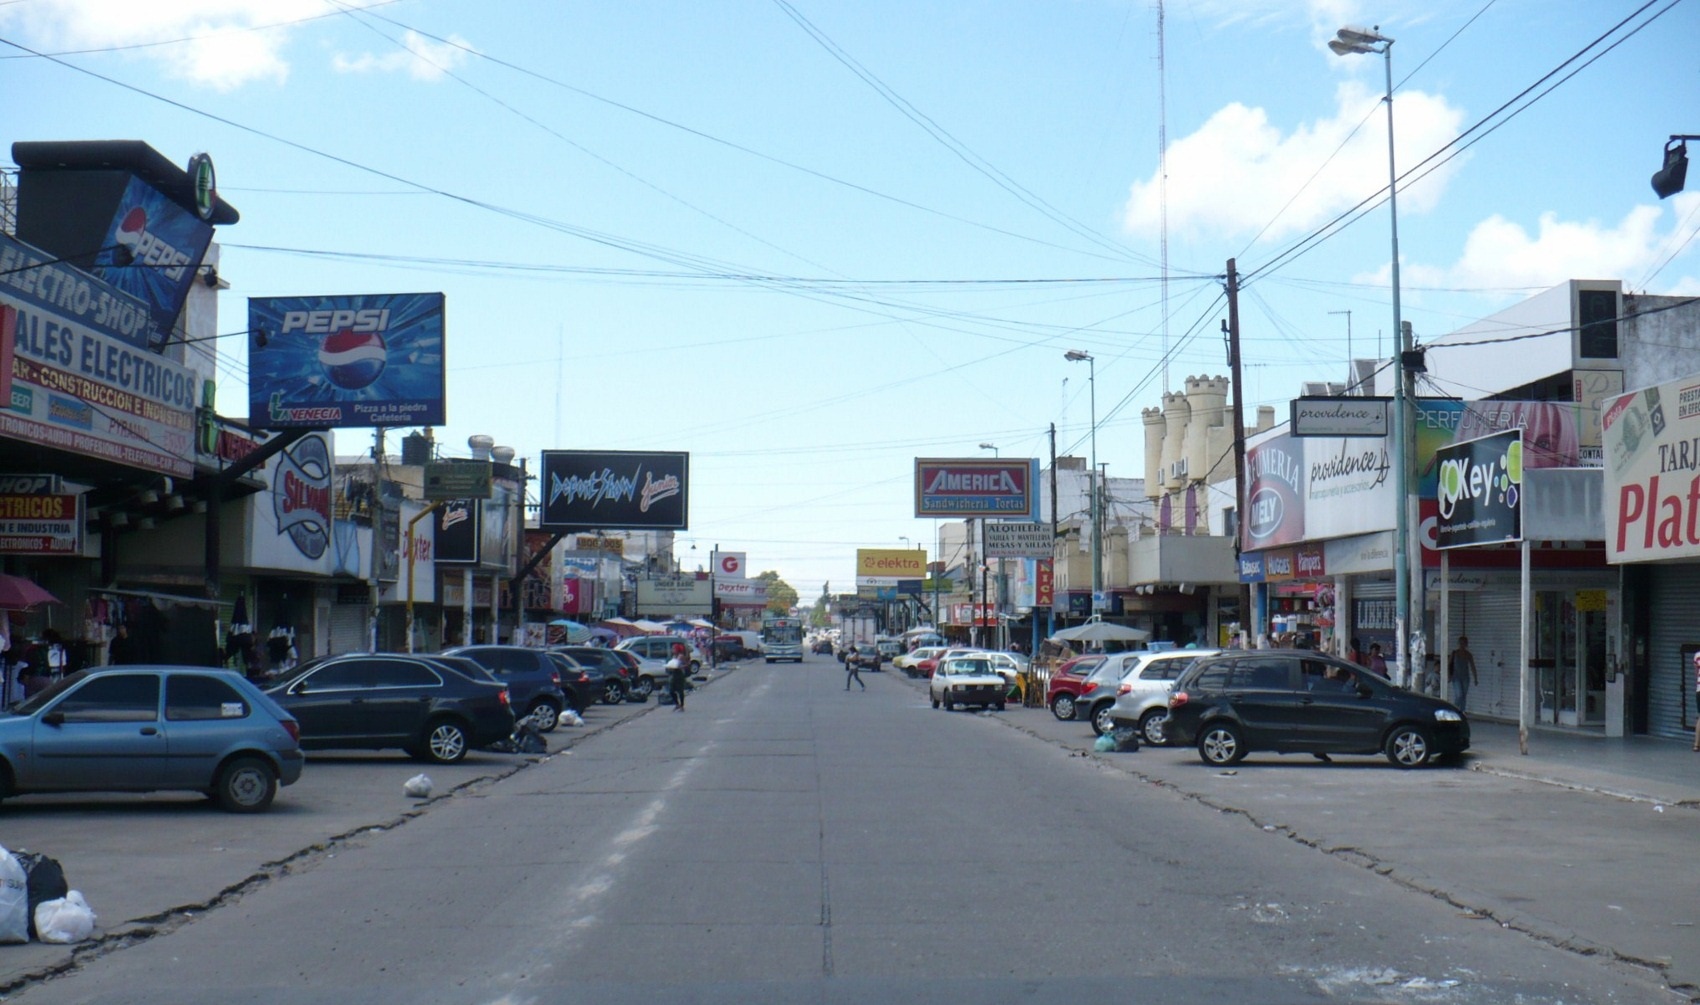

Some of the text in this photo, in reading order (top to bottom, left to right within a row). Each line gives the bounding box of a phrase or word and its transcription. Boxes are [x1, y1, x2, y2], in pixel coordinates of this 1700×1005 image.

[132, 230, 191, 282] PEPSI
[281, 309, 391, 333] PEPSI
[80, 335, 195, 410] ELECTRICOS
[40, 366, 132, 412] CONSTRUCCION
[134, 398, 141, 414] E
[290, 407, 342, 421] VENECIA
[354, 404, 378, 413] Pizza
[388, 404, 397, 412] la
[400, 403, 428, 414] piedra
[1297, 403, 1369, 425] providence
[1679, 405, 1687, 417] EN
[1415, 411, 1529, 430] PERFUMERIA
[1658, 438, 1700, 473] TARJ
[1309, 437, 1377, 500] providence
[925, 470, 1022, 494] AMERICA
[995, 497, 1024, 509] Tortas
[17, 523, 70, 533] INDUSTRIA
[988, 525, 1041, 533] ALQUILER
[403, 531, 430, 561] Dxter
[877, 558, 919, 569] elektra
[1298, 553, 1322, 576] Pampers
[718, 583, 749, 592] Dexter
